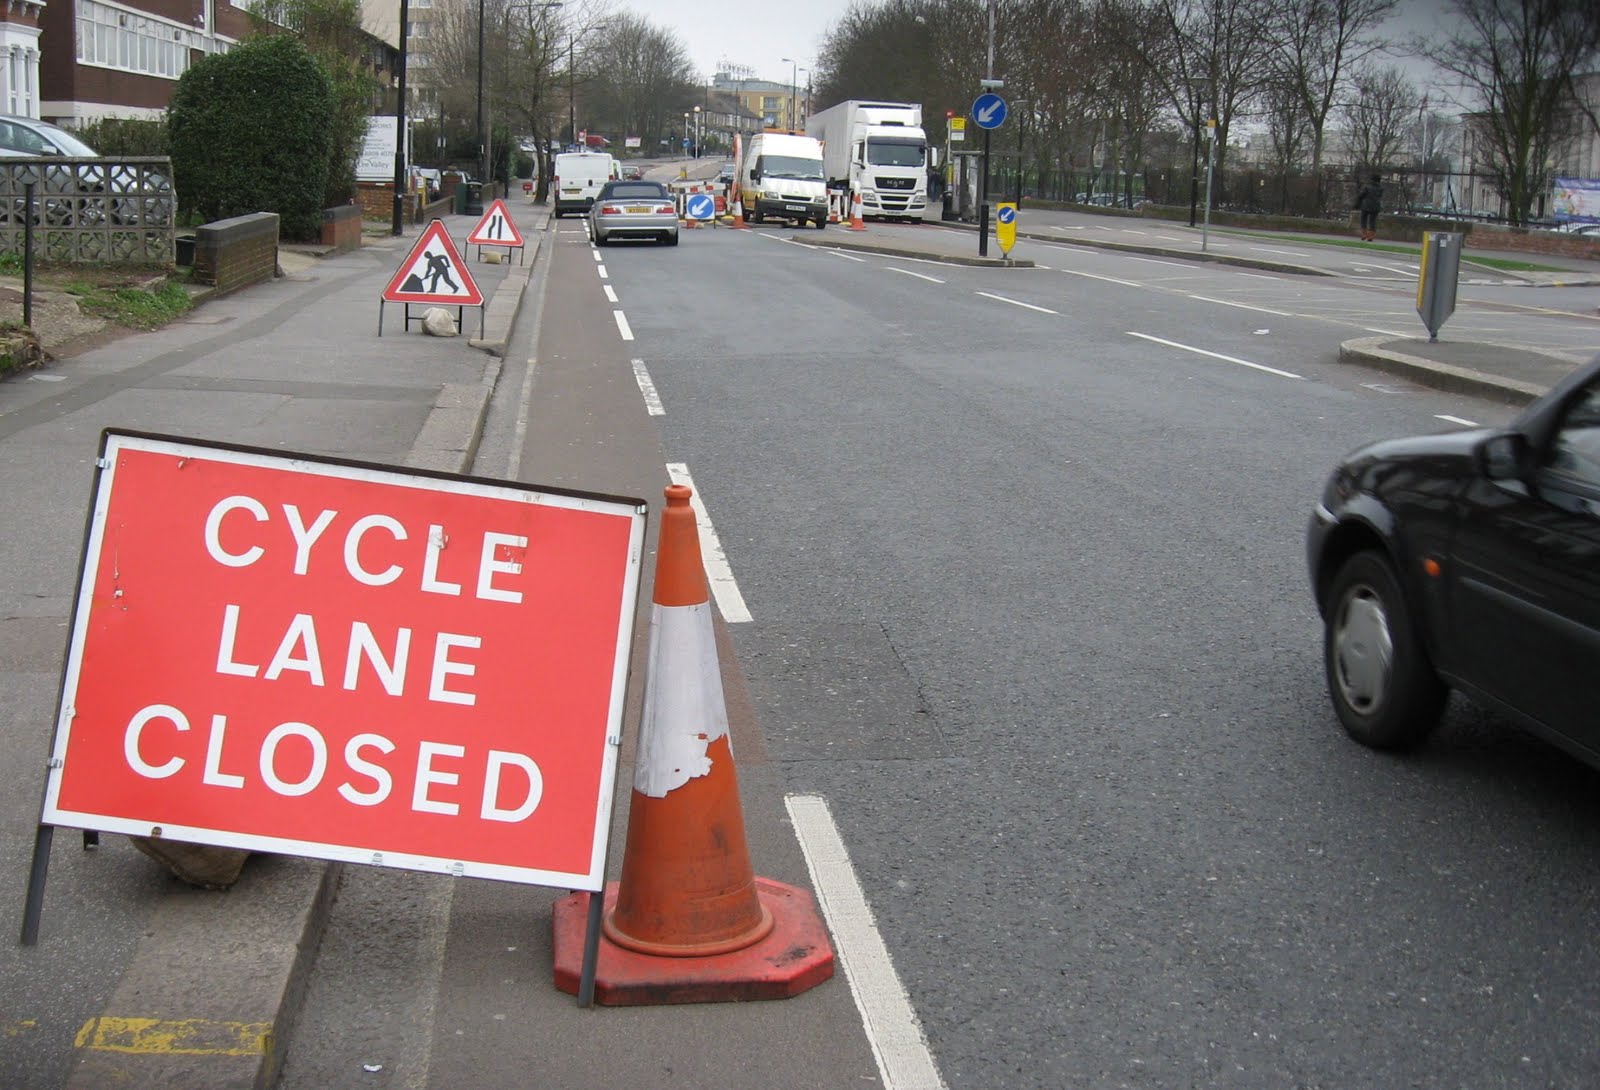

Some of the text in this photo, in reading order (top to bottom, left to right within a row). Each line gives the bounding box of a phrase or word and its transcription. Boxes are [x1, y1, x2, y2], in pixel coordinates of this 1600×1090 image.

[204, 495, 528, 604] CYCLE
[215, 604, 482, 706] LANE
[124, 703, 544, 823] CLOSED
